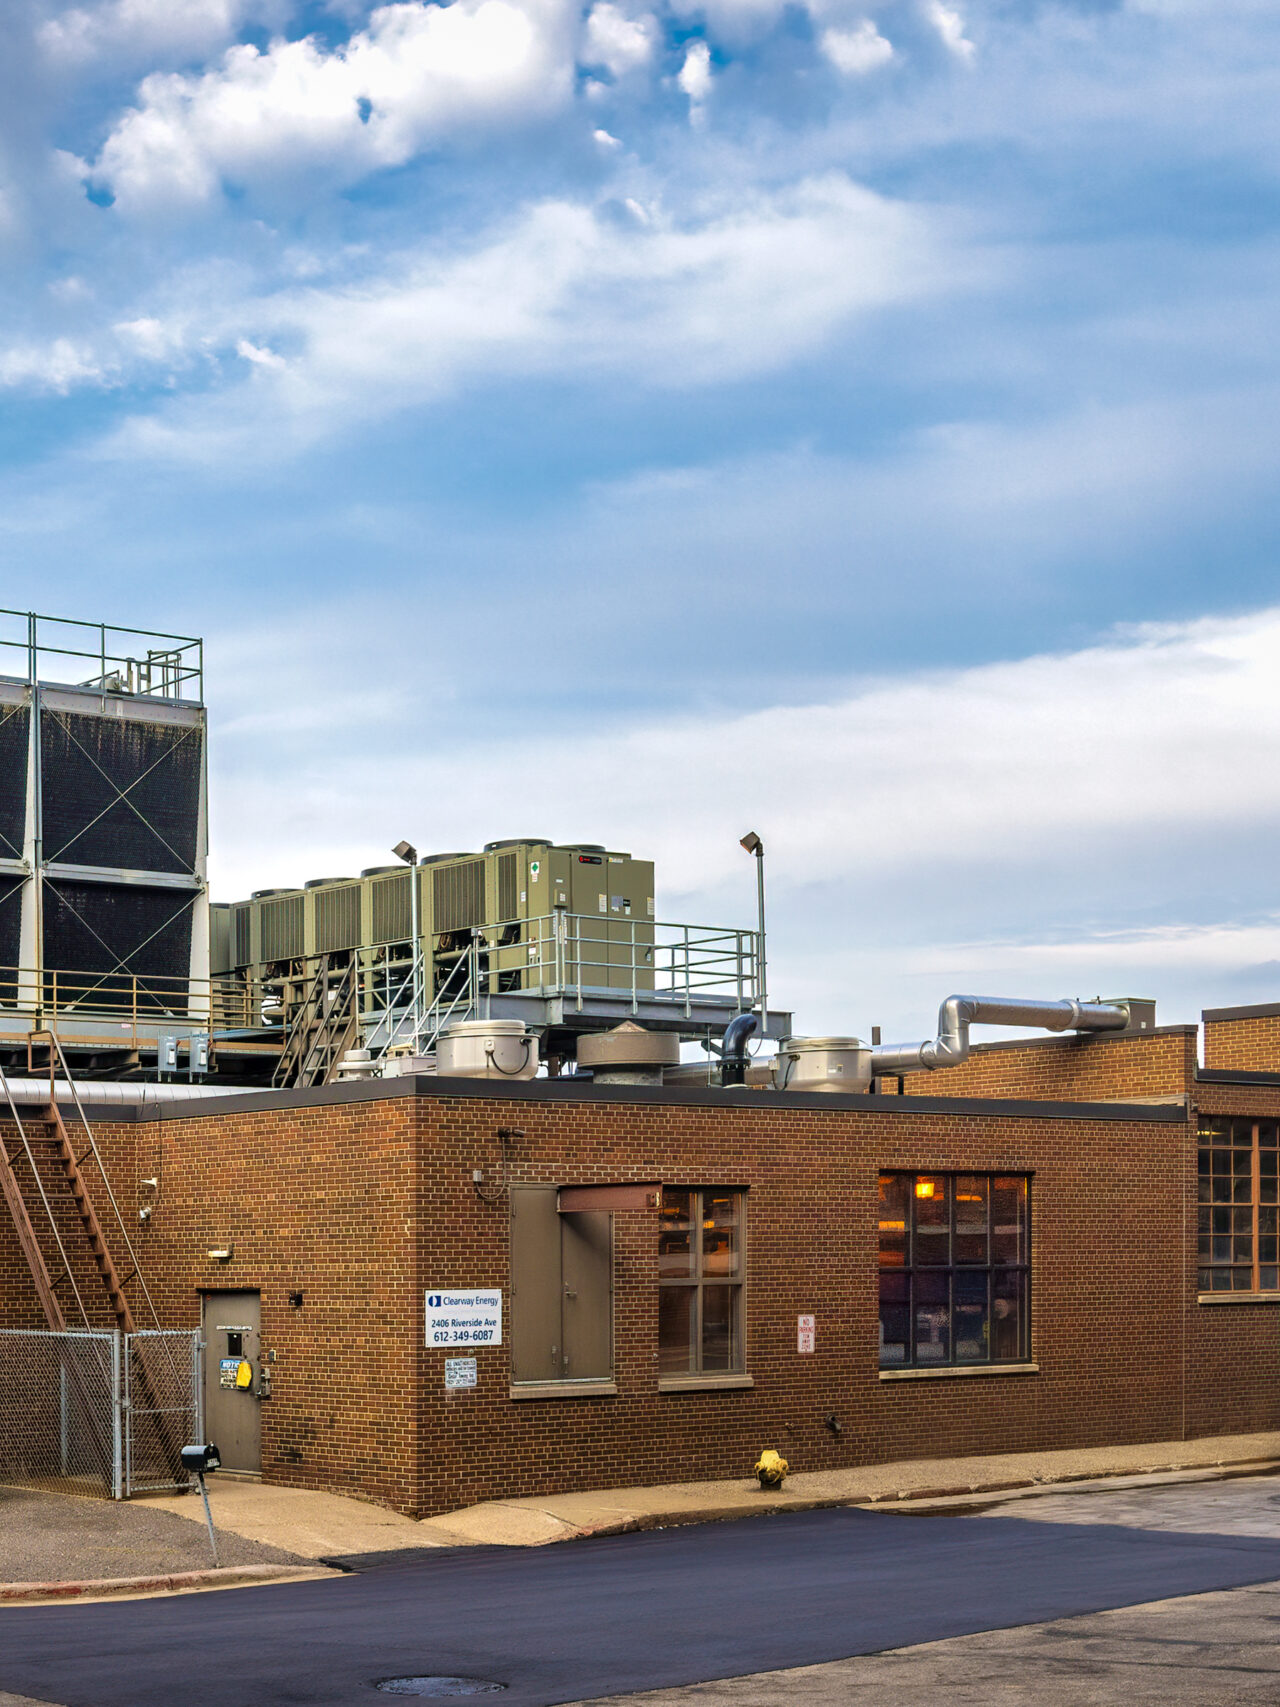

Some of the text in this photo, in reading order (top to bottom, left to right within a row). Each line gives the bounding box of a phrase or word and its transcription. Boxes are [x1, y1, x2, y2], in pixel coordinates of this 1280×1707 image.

[443, 1296, 498, 1307] Clearway Energy
[431, 1318, 497, 1328] 2406 Riverside Ave
[433, 1330, 494, 1342] 612-349-6087
